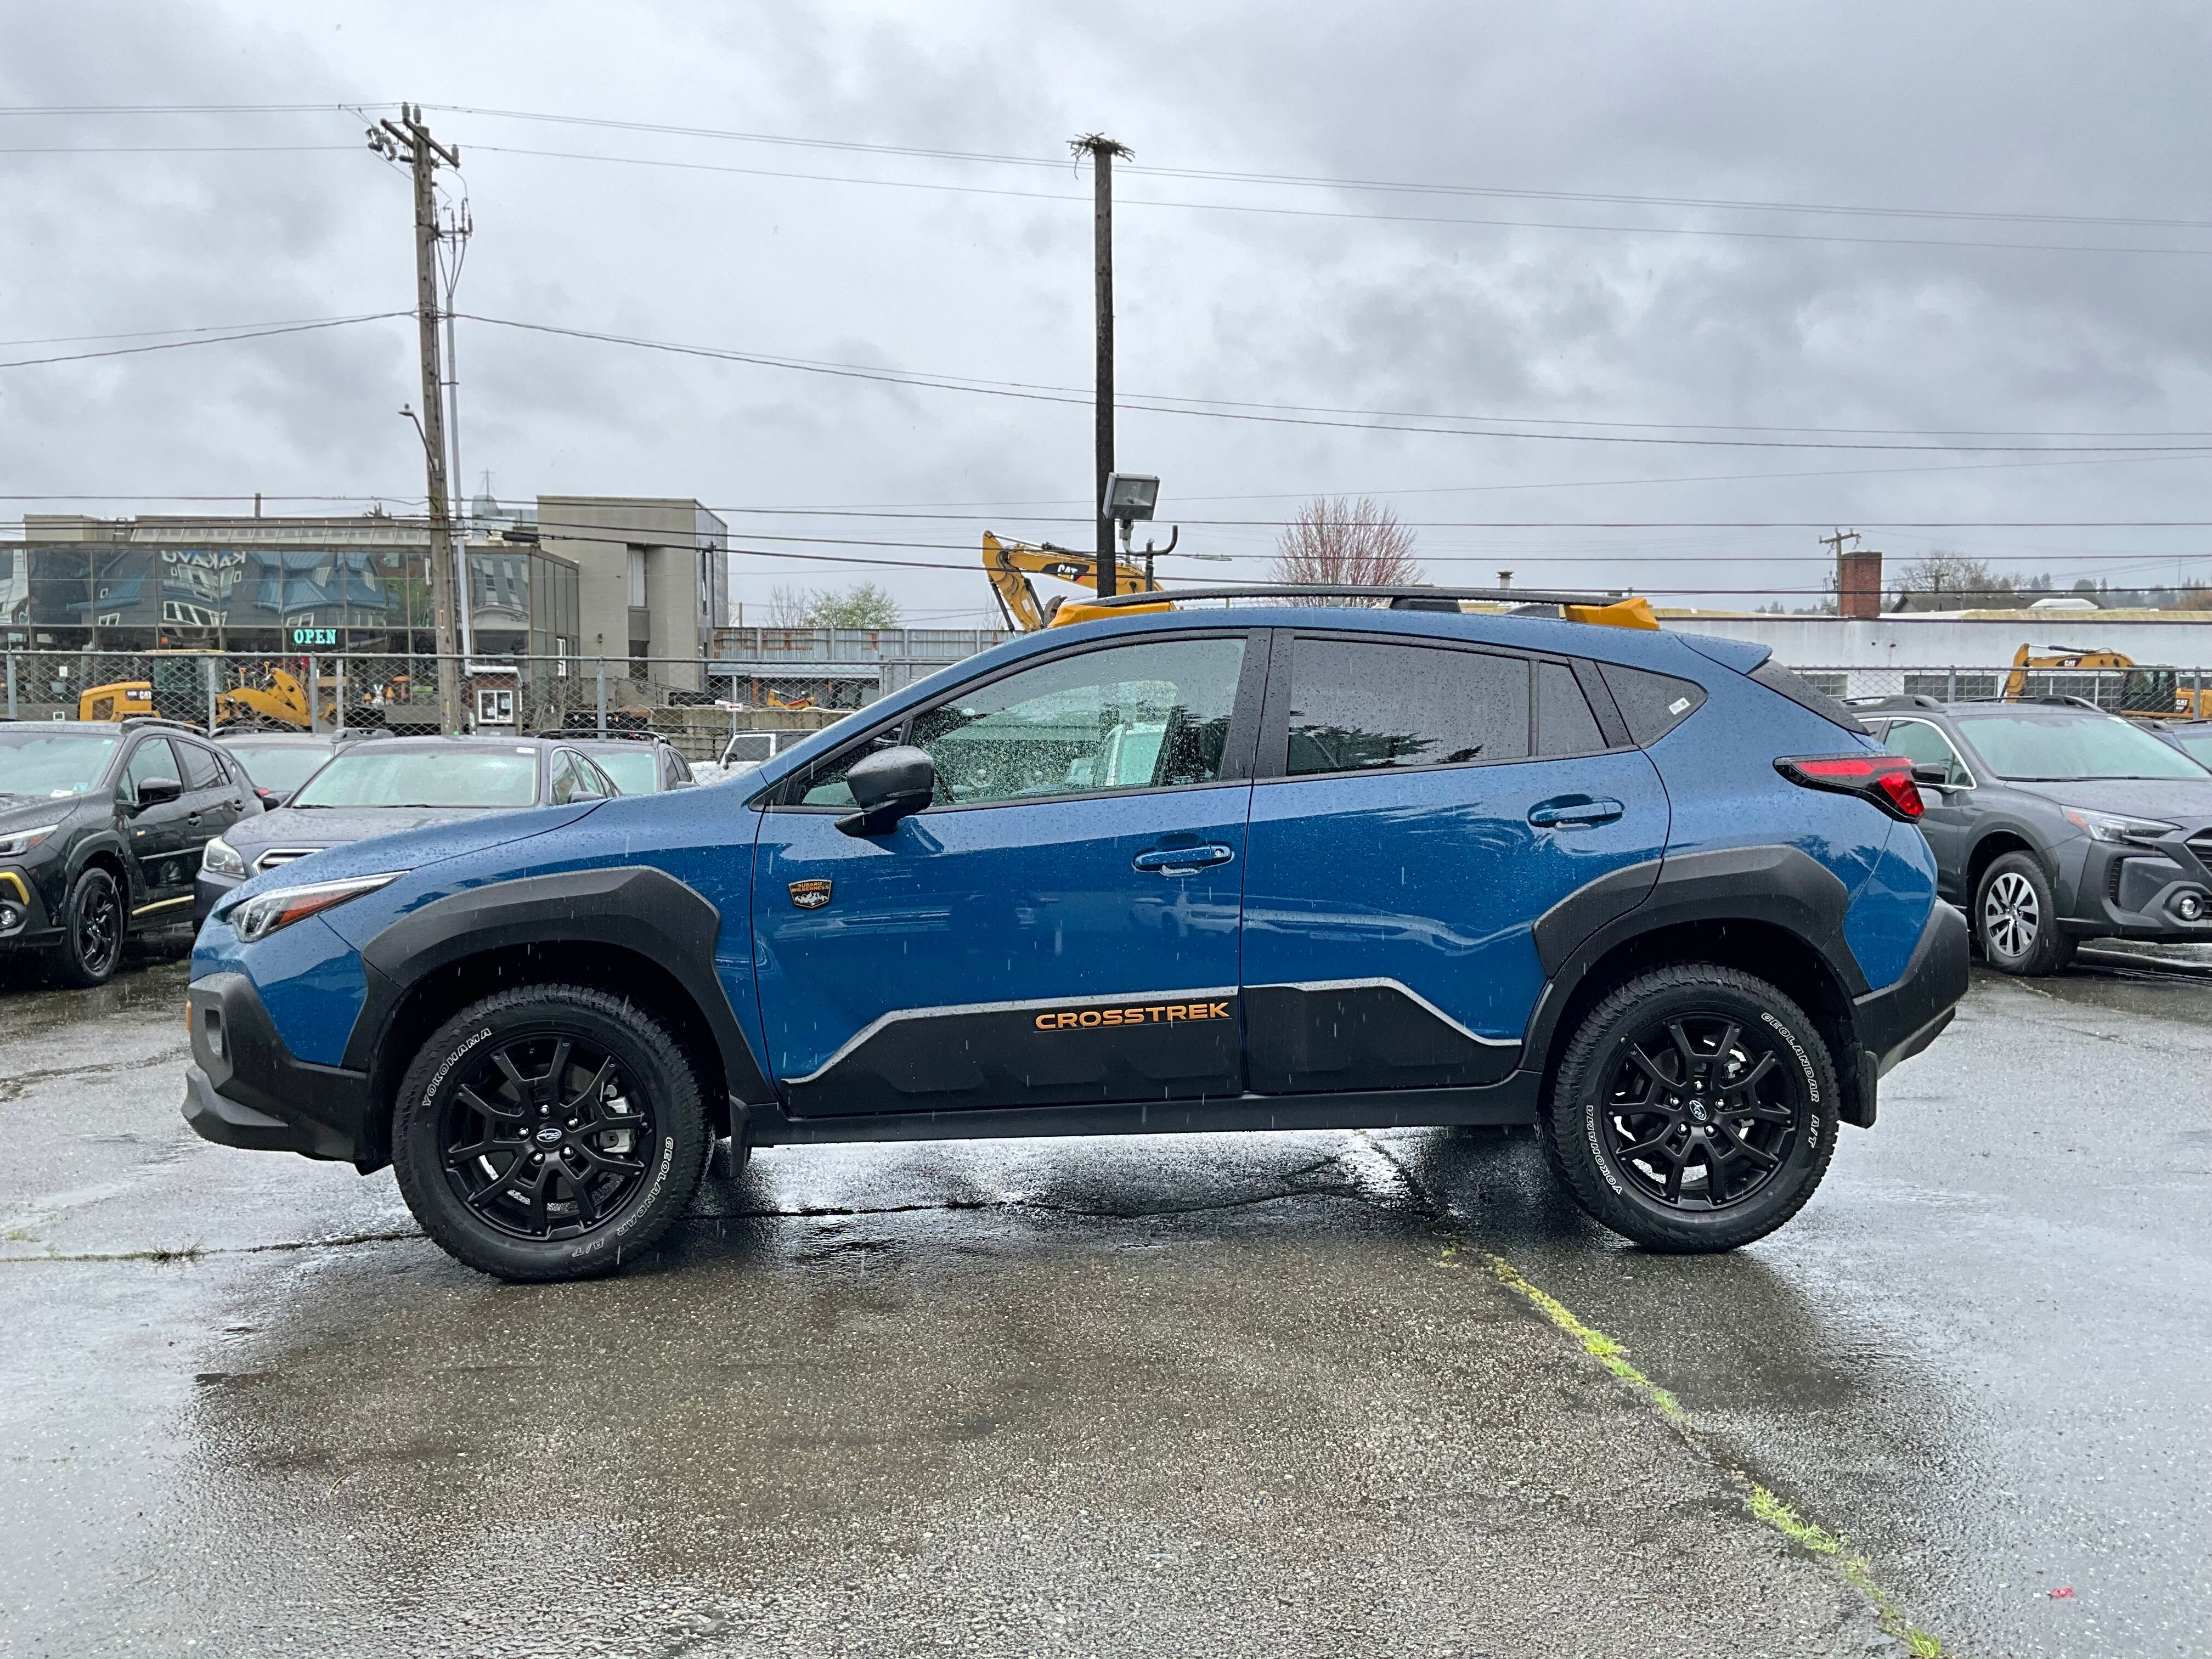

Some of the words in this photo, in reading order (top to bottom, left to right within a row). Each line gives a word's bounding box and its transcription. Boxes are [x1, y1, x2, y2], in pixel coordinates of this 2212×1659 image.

[1058, 564, 1078, 580] CAT
[294, 629, 336, 644] OPEN
[1035, 1002, 1229, 1030] CROSSTREK
[421, 1028, 492, 1107] YOKOHAMA
[1761, 1012, 1820, 1103] GEOLANDAR
[1808, 1114, 1820, 1148] A/T
[1586, 1105, 1623, 1195] YOKOHAMA
[616, 1137, 673, 1236] GEOLANDAR
[572, 1238, 604, 1257] A/T
